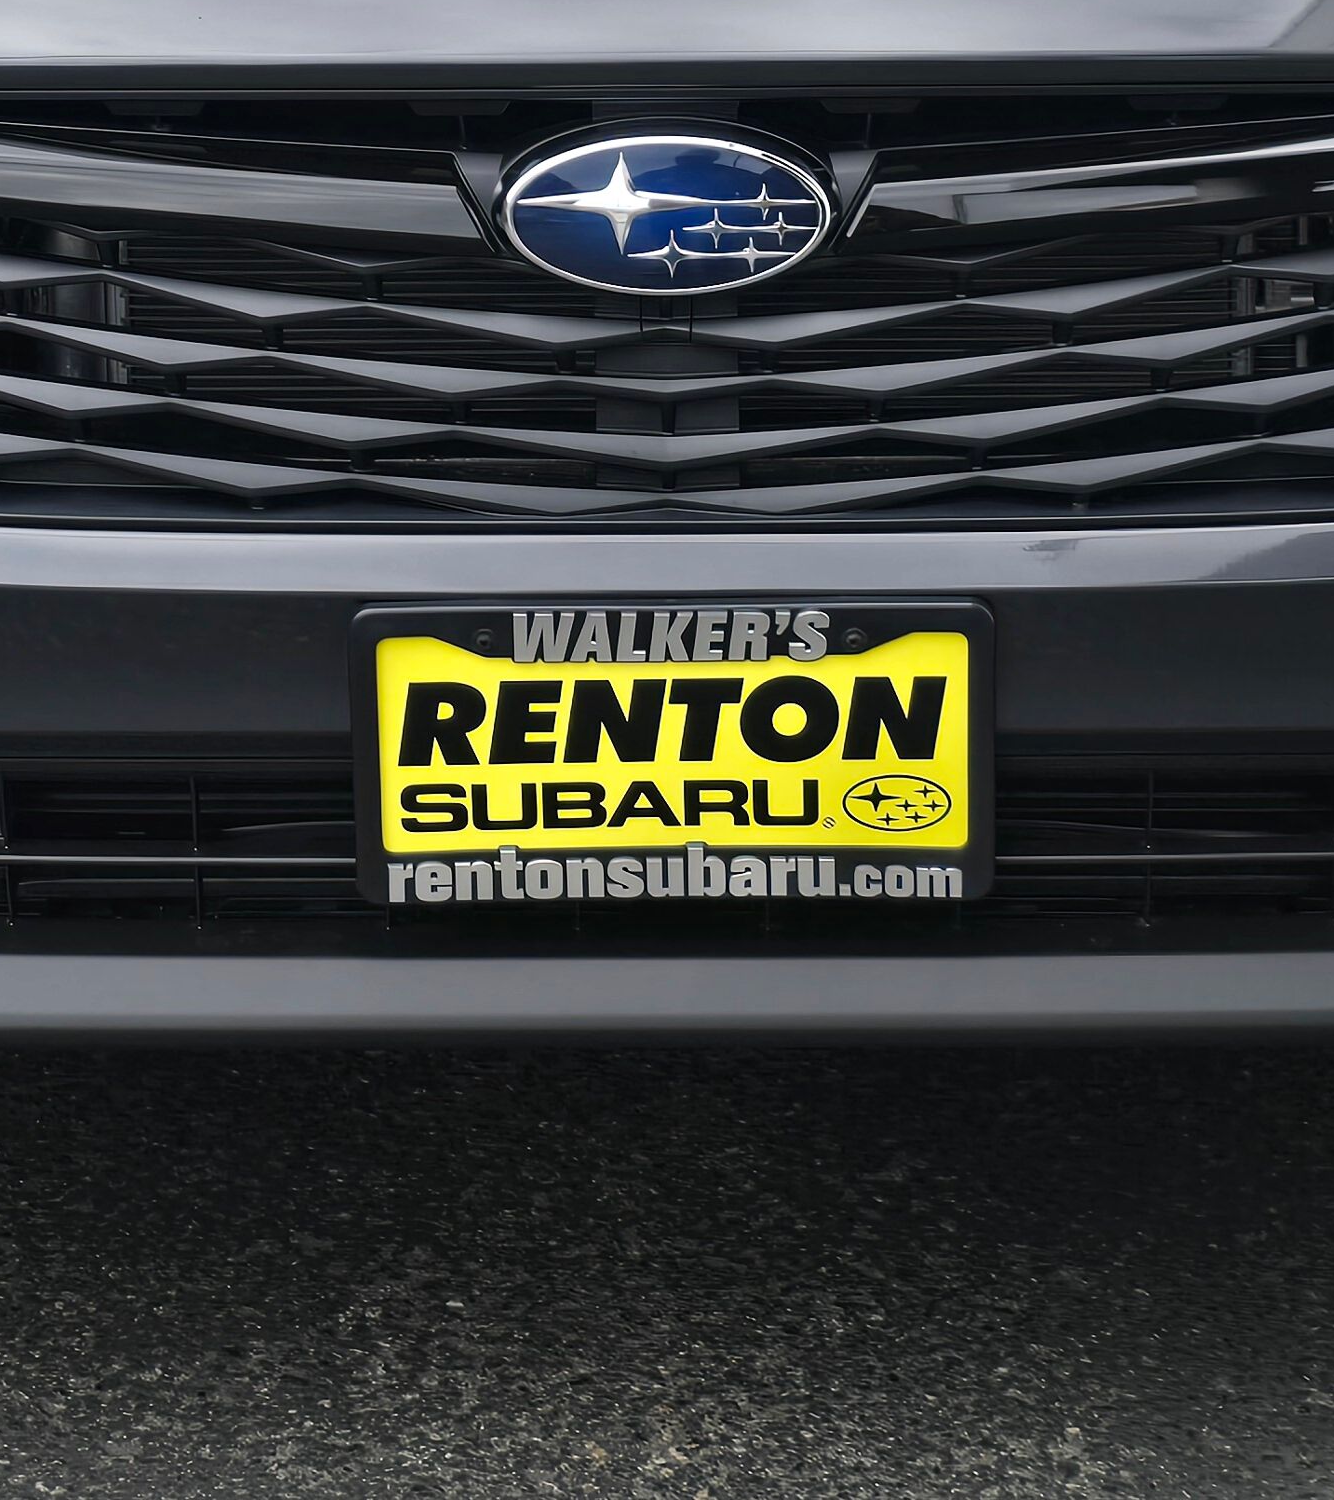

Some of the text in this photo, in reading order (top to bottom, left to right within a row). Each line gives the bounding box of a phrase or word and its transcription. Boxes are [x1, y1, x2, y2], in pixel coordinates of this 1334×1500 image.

[511, 610, 830, 663] WALKER'S
[397, 675, 947, 767] RENTON
[399, 779, 819, 832] SUBARU
[387, 843, 963, 903] rentonsubaru.com
